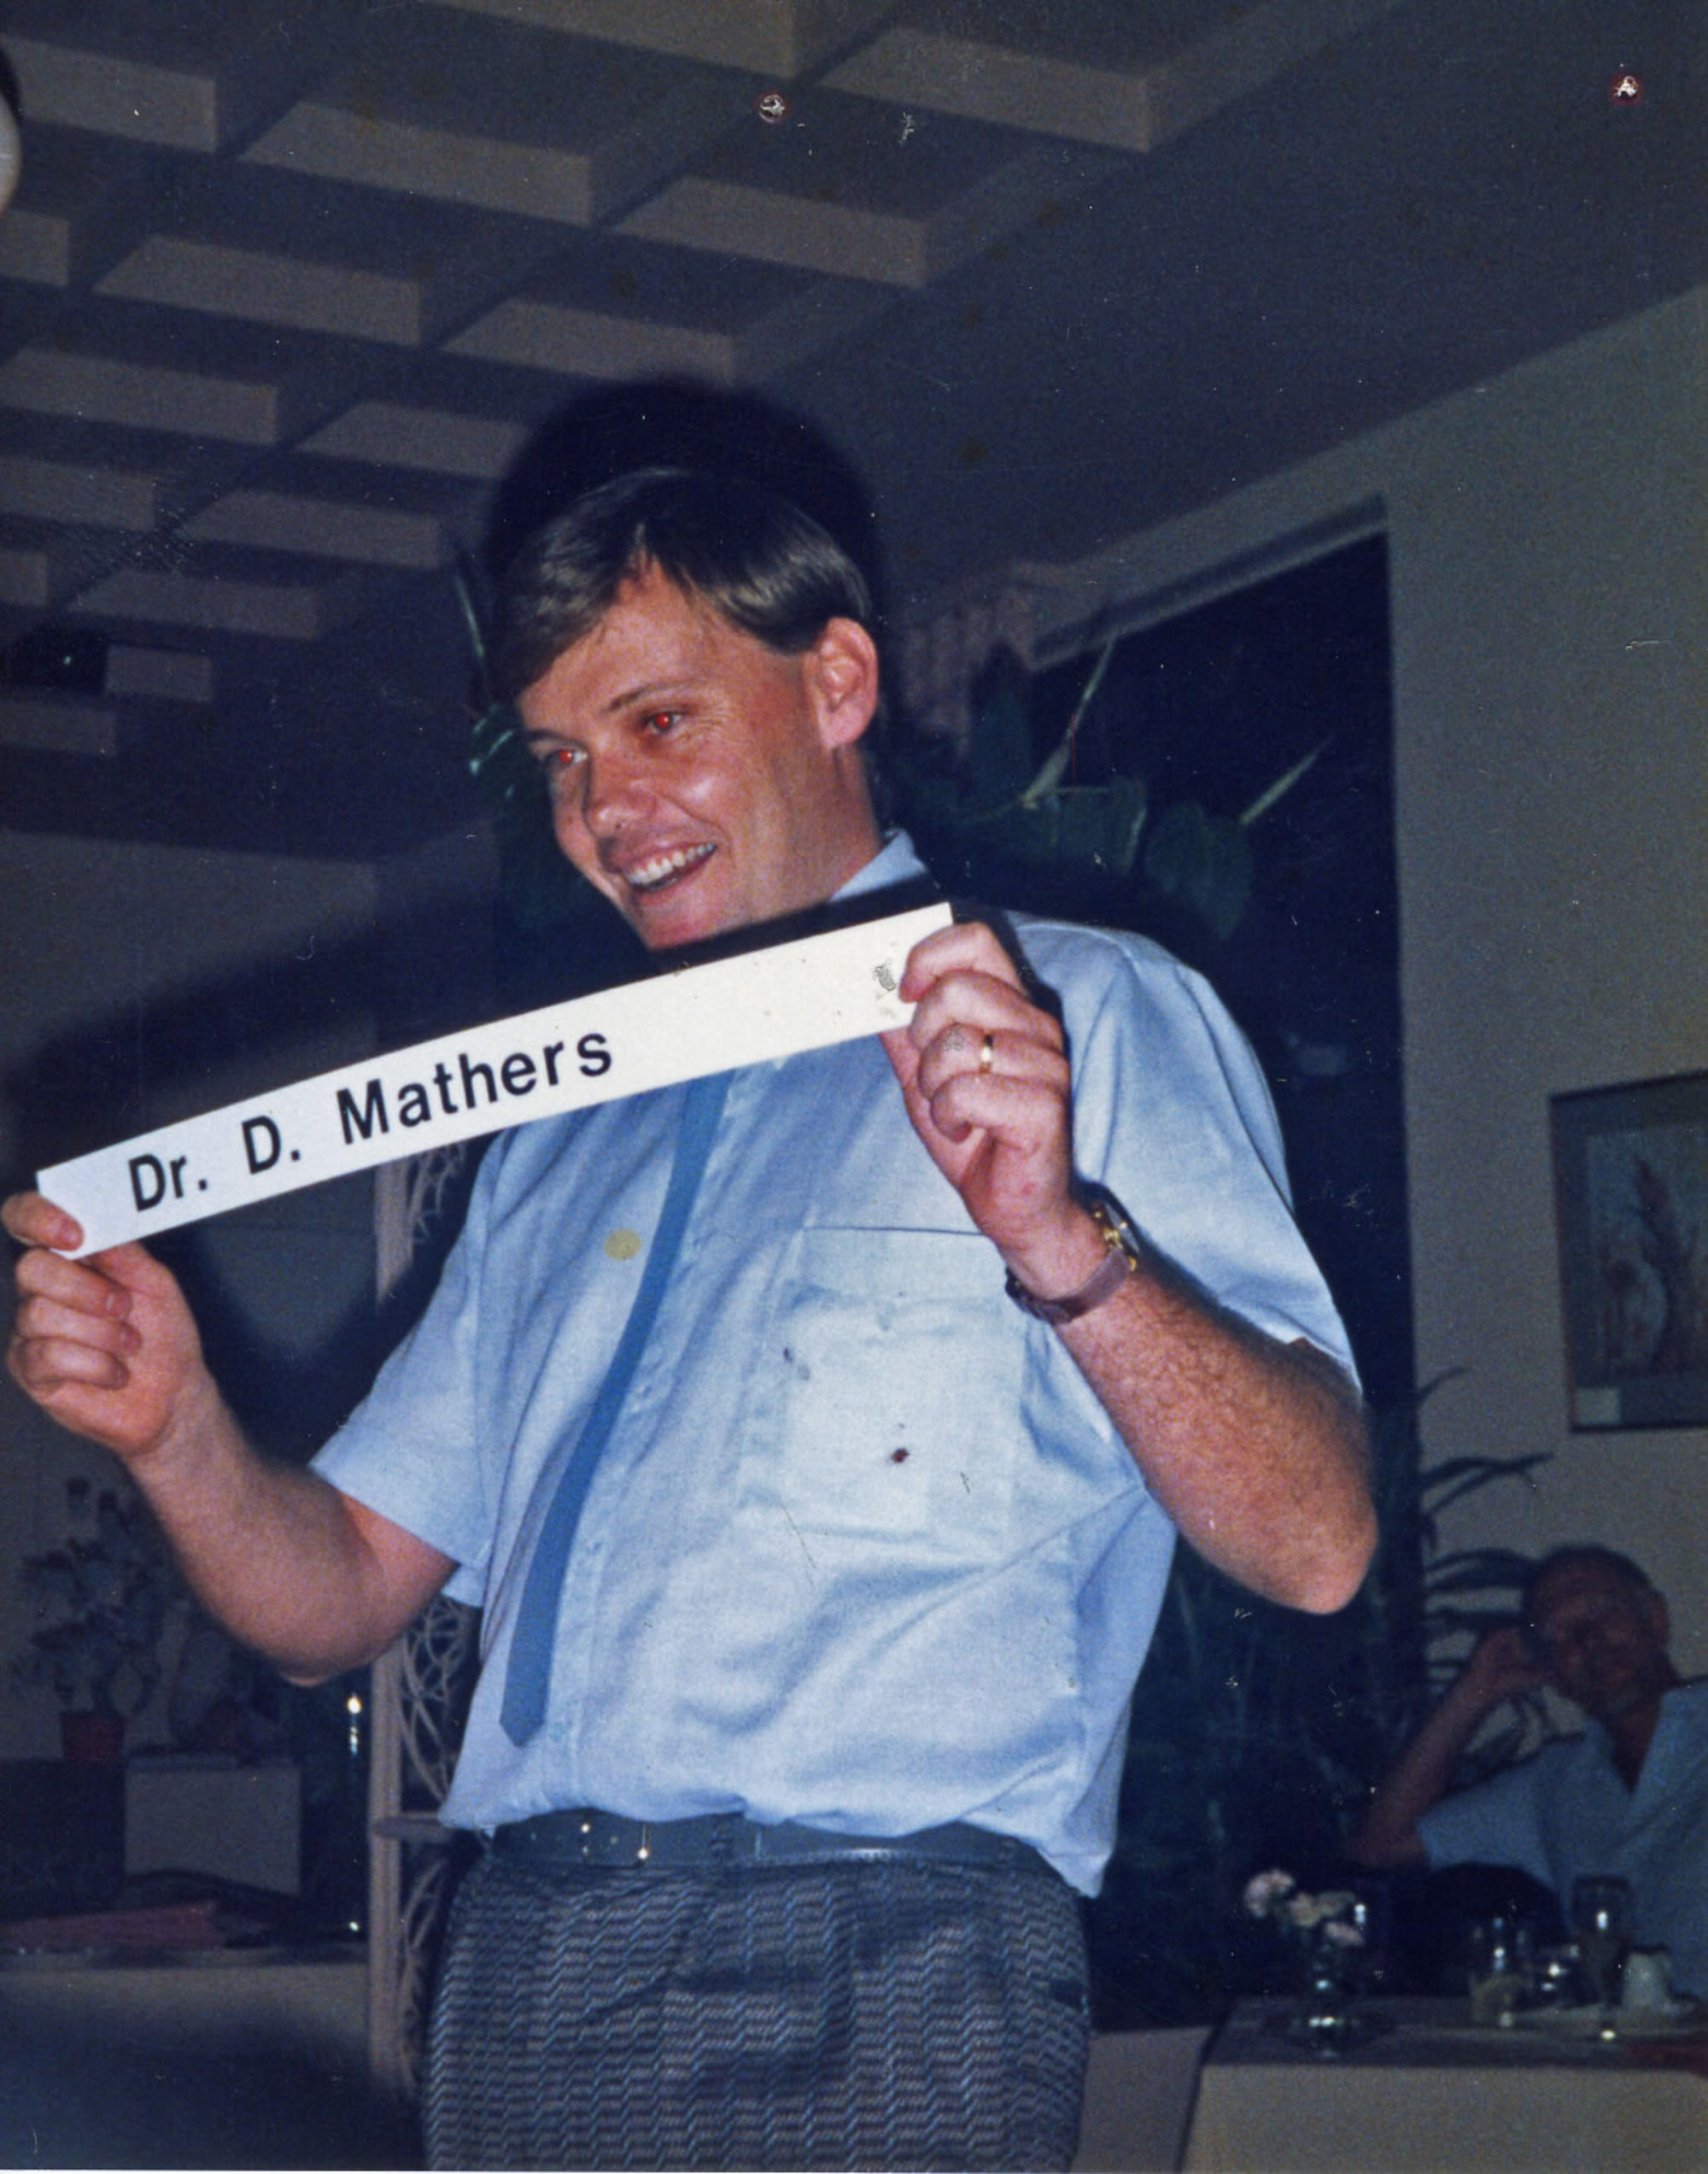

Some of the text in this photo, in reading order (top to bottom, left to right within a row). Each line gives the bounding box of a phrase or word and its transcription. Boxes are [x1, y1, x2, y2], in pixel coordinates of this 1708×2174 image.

[128, 1034, 611, 1212] Dr. D. Mathers
